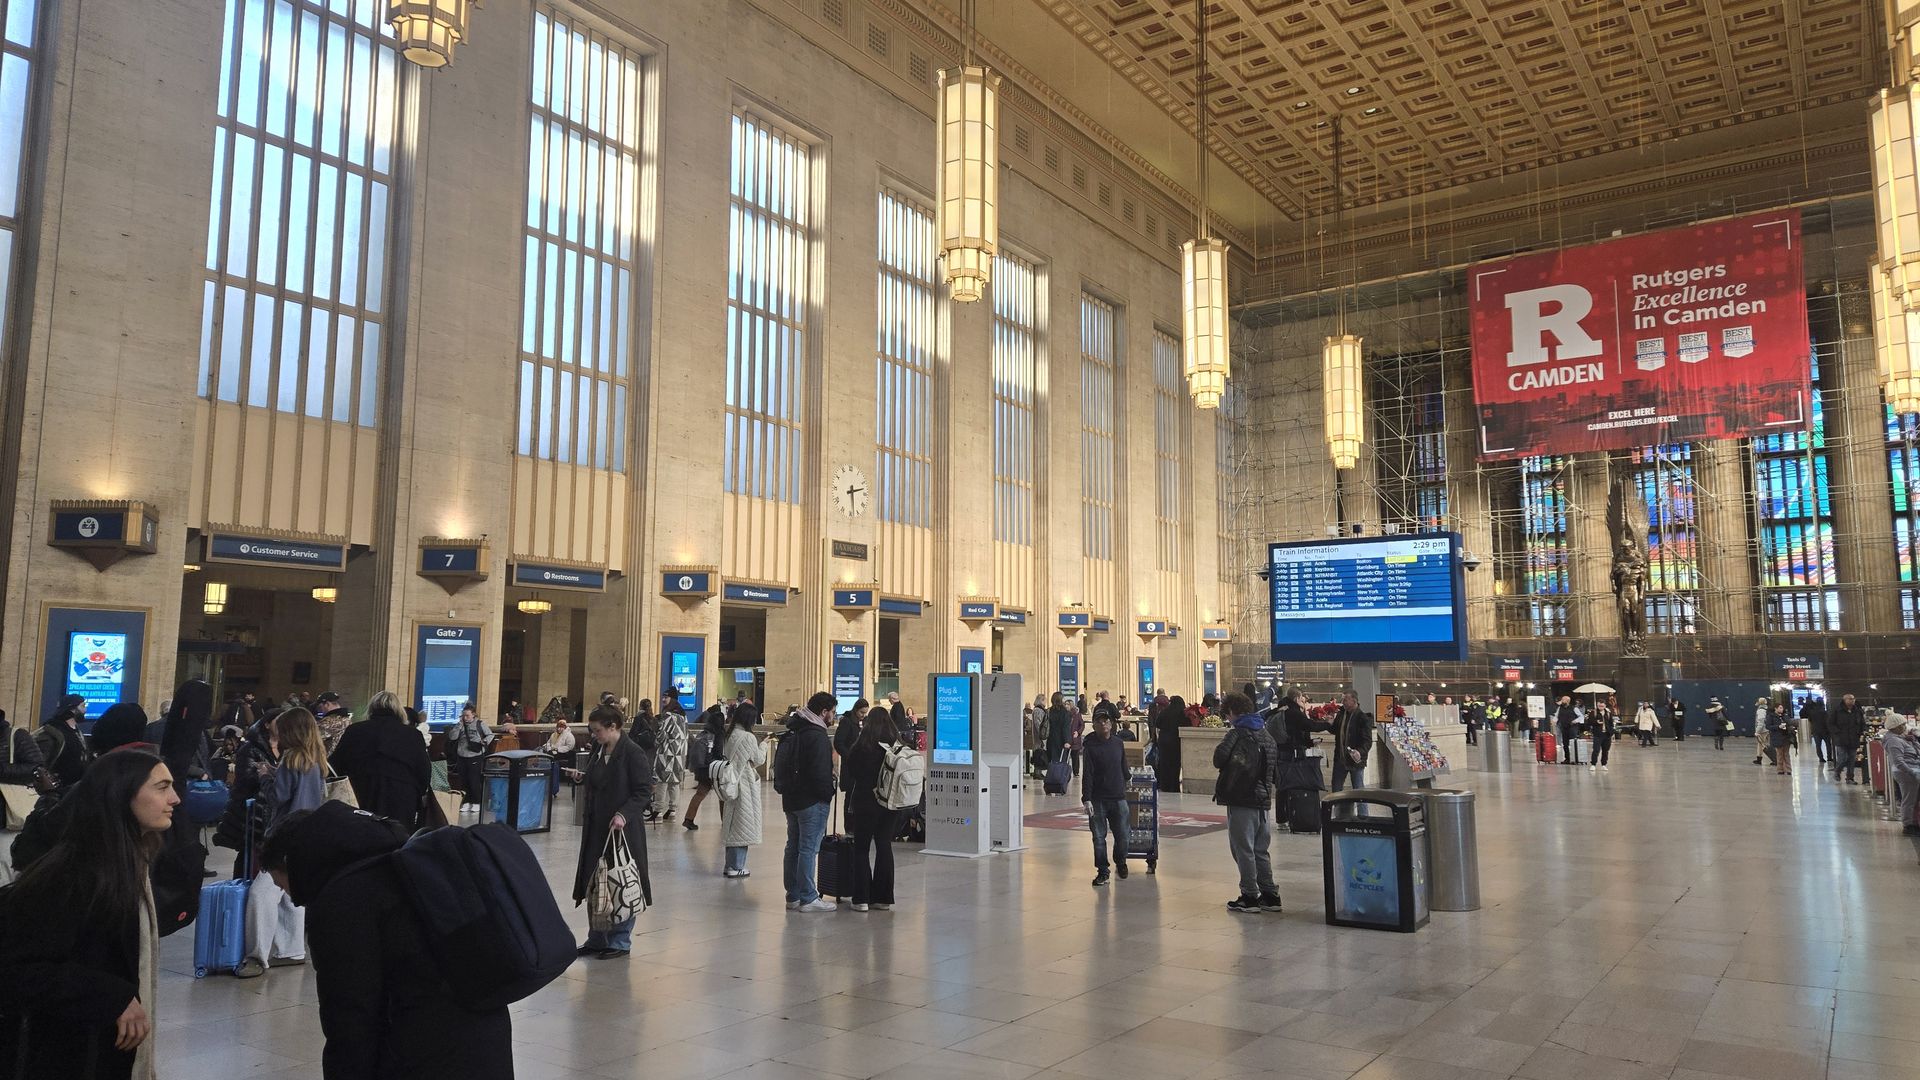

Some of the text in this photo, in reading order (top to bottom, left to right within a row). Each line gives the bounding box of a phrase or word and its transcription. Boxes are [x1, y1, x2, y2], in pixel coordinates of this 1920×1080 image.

[1632, 264, 1727, 290] Rutgers
[1632, 282, 1747, 312] Excellence
[1634, 300, 1766, 330] In Camden
[1504, 284, 1603, 368] R
[1681, 334, 1706, 343] BEST
[1725, 328, 1750, 337] BEST
[1638, 340, 1662, 348] BEST
[1508, 362, 1604, 391] CAMDEN
[1608, 407, 1655, 419] EXCEL HERE
[1588, 415, 1678, 430] CAMDEN.RUTGERS.EDU/EXCEL
[251, 546, 318, 559] Customer Service
[445, 554, 454, 567] 7
[551, 573, 579, 581] Restrooms
[849, 594, 856, 603] 5
[437, 629, 456, 637] Gate
[939, 687, 951, 695] Plug
